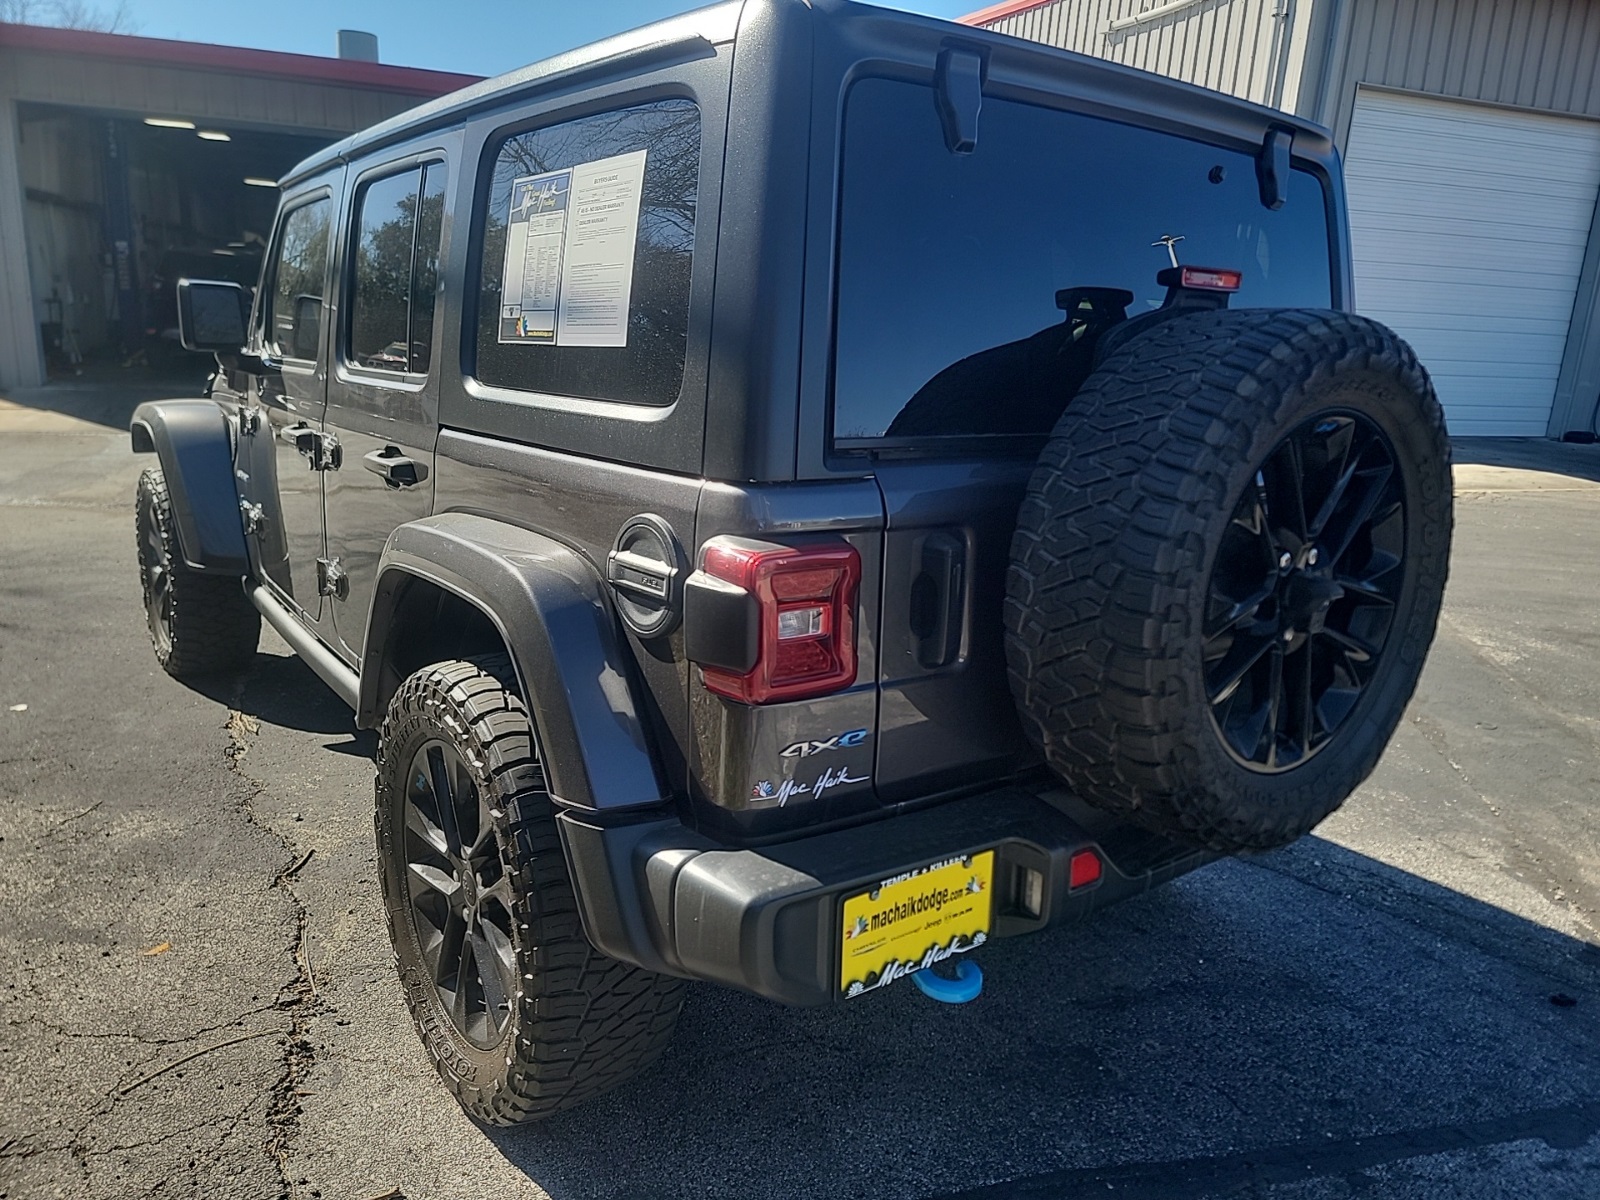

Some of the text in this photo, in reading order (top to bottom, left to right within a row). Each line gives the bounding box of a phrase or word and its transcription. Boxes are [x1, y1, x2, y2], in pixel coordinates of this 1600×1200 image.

[769, 766, 862, 808] Mac Haik
[880, 869, 919, 889] TEMPLE
[870, 887, 964, 932] machaikdodge.com
[876, 936, 966, 989] Mac Haik
